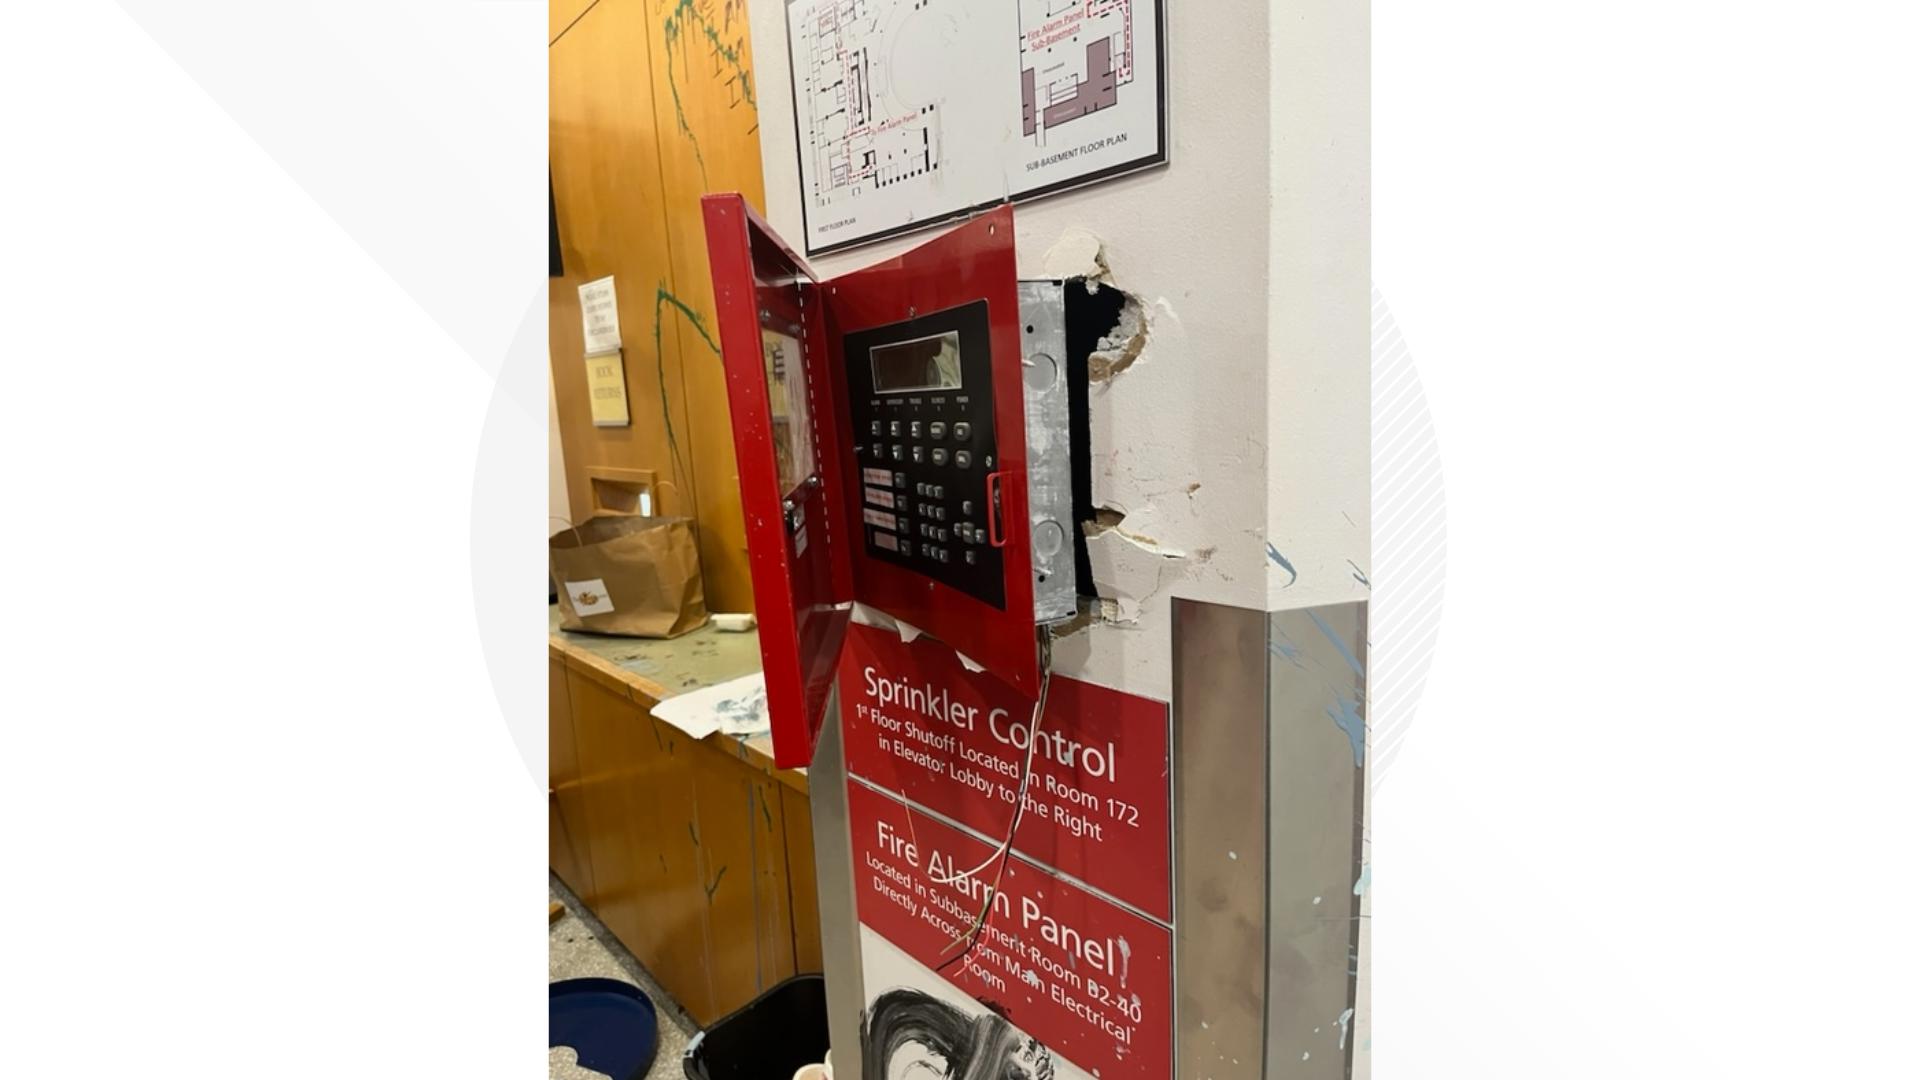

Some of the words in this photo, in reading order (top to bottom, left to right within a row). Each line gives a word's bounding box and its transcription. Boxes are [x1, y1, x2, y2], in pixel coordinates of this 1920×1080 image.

[1027, 29, 1041, 41] Fire
[1042, 19, 1063, 35] Alarm
[1063, 7, 1084, 25] Panel
[1080, 139, 1105, 155] FLOOR
[1106, 131, 1128, 146] PLAN
[856, 703, 868, 719] 1st
[871, 709, 902, 733] Floor
[905, 721, 955, 754] Shutoff
[959, 741, 1019, 780] Located
[1045, 771, 1099, 811] Room
[1105, 798, 1140, 828] 172
[864, 666, 979, 732] Sprinkler
[988, 707, 1115, 783] Control
[878, 736, 890, 750] in
[894, 741, 946, 775] Elevator
[950, 762, 994, 798] Lobby
[998, 783, 1017, 804] to
[1053, 804, 1103, 841] Right
[866, 850, 912, 889] Located
[914, 878, 926, 898] in
[1030, 946, 1081, 990] Room
[1087, 977, 1142, 1024] B2-40
[877, 820, 919, 868] Fire
[927, 849, 1010, 919] Alarm
[1022, 896, 1114, 977] Panel
[873, 875, 917, 917] Directly
[921, 906, 961, 940] Across
[1051, 983, 1131, 1045] Electrical
[963, 953, 1006, 994] Room
